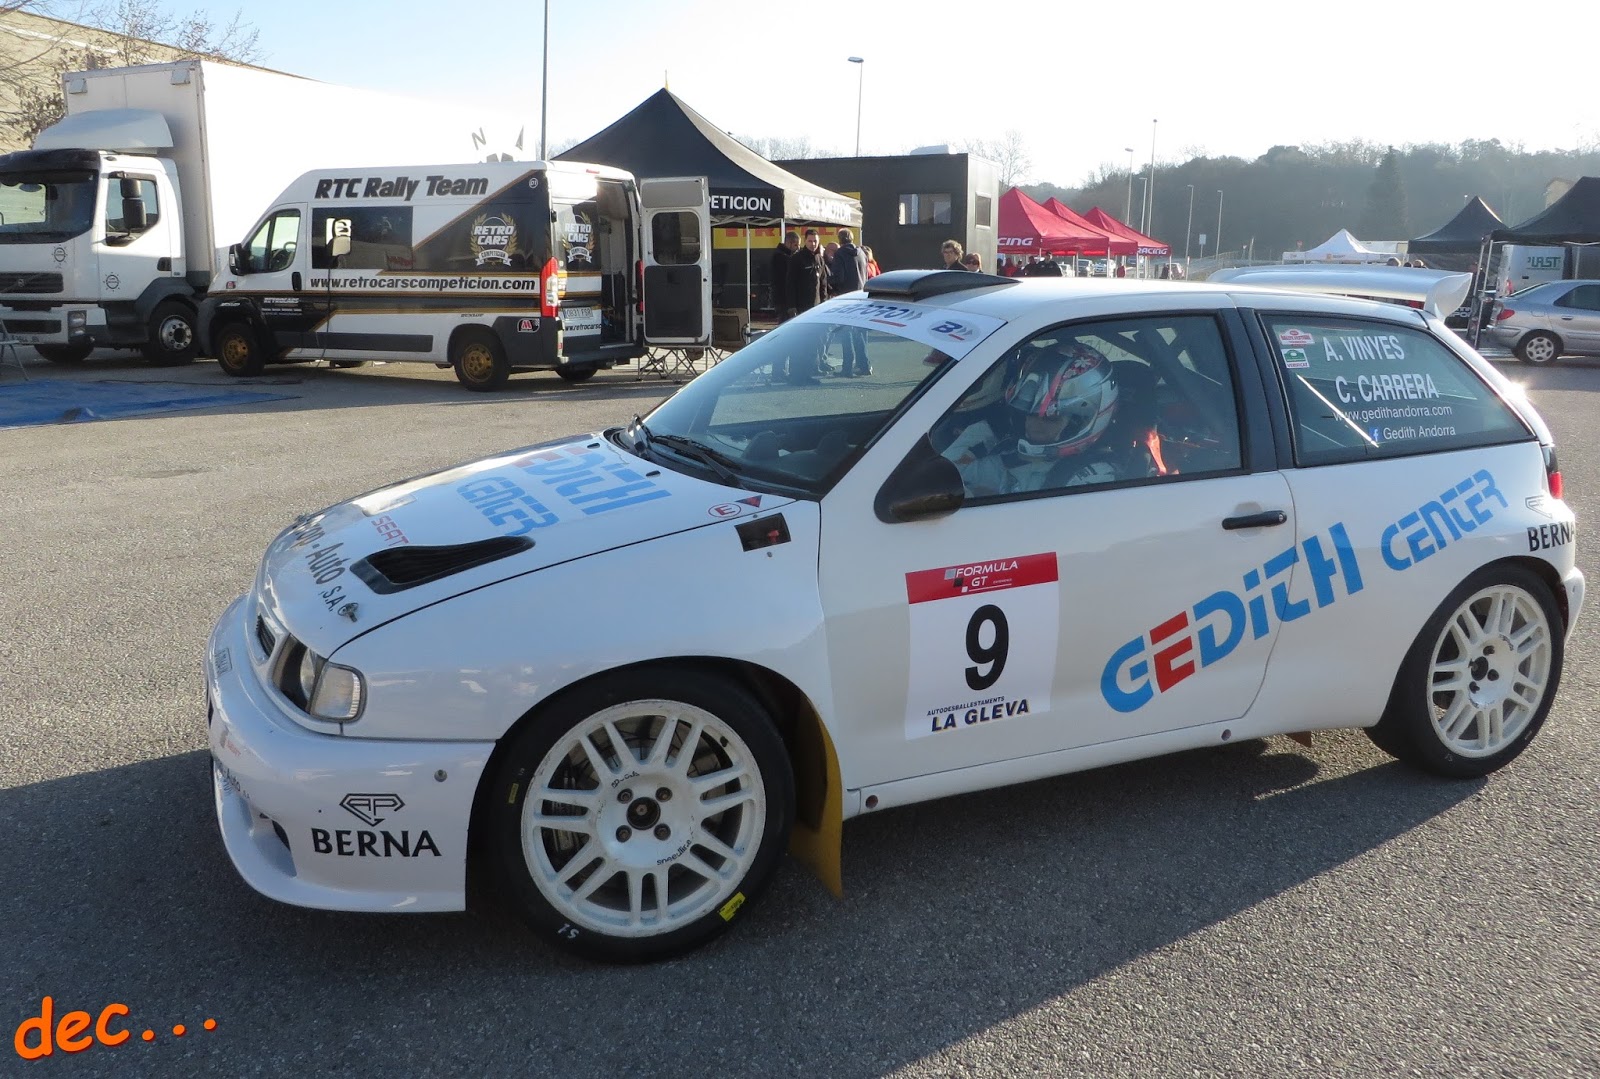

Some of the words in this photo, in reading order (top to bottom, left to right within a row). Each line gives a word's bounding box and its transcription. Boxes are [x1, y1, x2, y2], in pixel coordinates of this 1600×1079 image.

[315, 178, 363, 199] RTC
[363, 176, 420, 201] Rally
[426, 175, 489, 196] Team
[474, 225, 515, 235] RETRO
[565, 223, 591, 233] RETRO
[568, 232, 589, 243] CARS
[477, 235, 509, 245] CARS
[310, 276, 535, 291] www.retrocarscompeticion.com
[1322, 336, 1344, 362] A.
[1340, 335, 1405, 361] VINYES
[1335, 375, 1356, 404] C.
[1357, 373, 1440, 402] CARRERA
[1383, 427, 1417, 440] Gedith
[1418, 425, 1457, 438] Andorra
[1380, 468, 1509, 571] CENTER
[371, 515, 410, 548] SEAT
[955, 560, 1019, 578] FORMULA
[971, 576, 988, 587] GT
[965, 604, 1009, 690] 9
[927, 695, 1005, 716] AUTODESBALLESTAMENTS
[931, 713, 957, 732] LA
[964, 698, 1029, 726] GLEVA
[311, 828, 442, 857] BERNA
